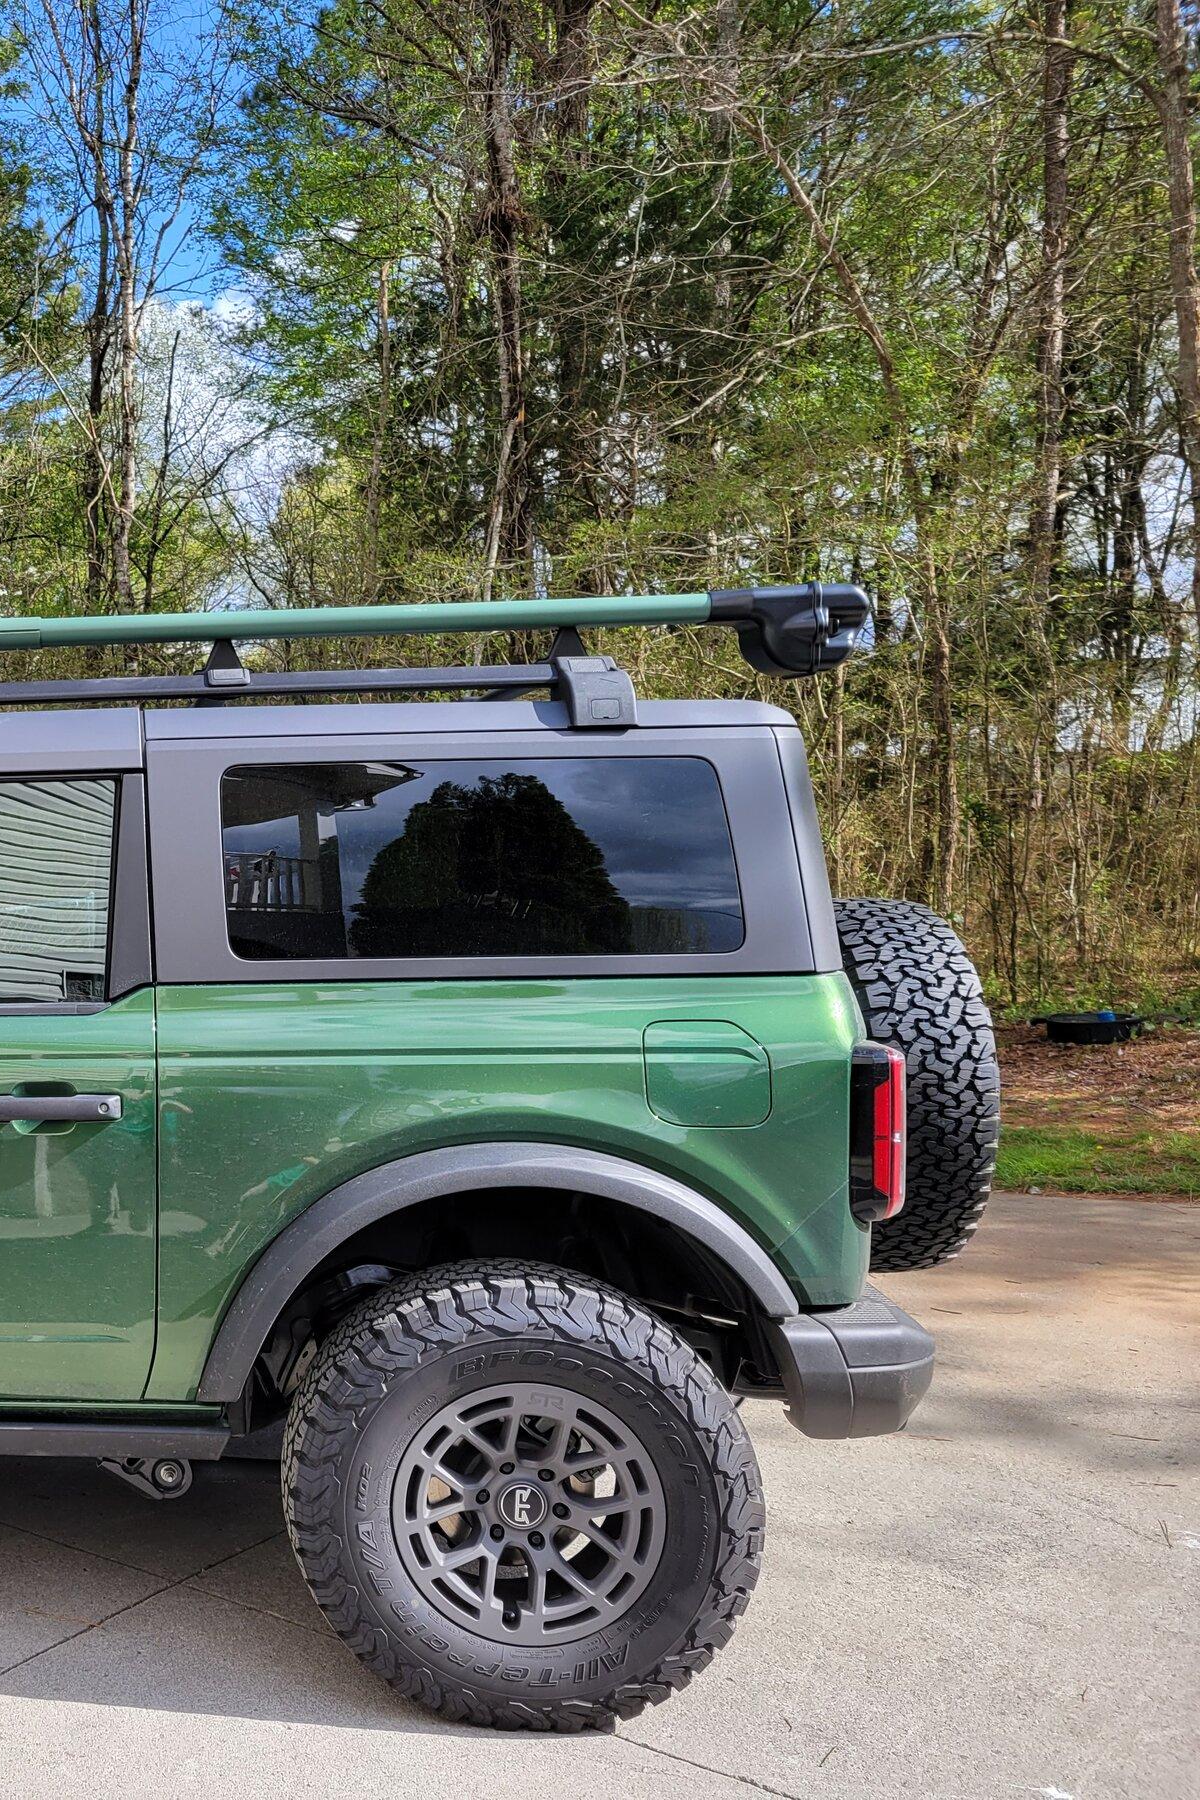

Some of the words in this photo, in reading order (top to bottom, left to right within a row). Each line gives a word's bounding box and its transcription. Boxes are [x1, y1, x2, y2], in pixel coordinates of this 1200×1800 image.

[454, 1349, 700, 1488] BFGoodrich
[357, 1520, 395, 1597] T/A
[390, 1599, 630, 1688] All-Terrain
